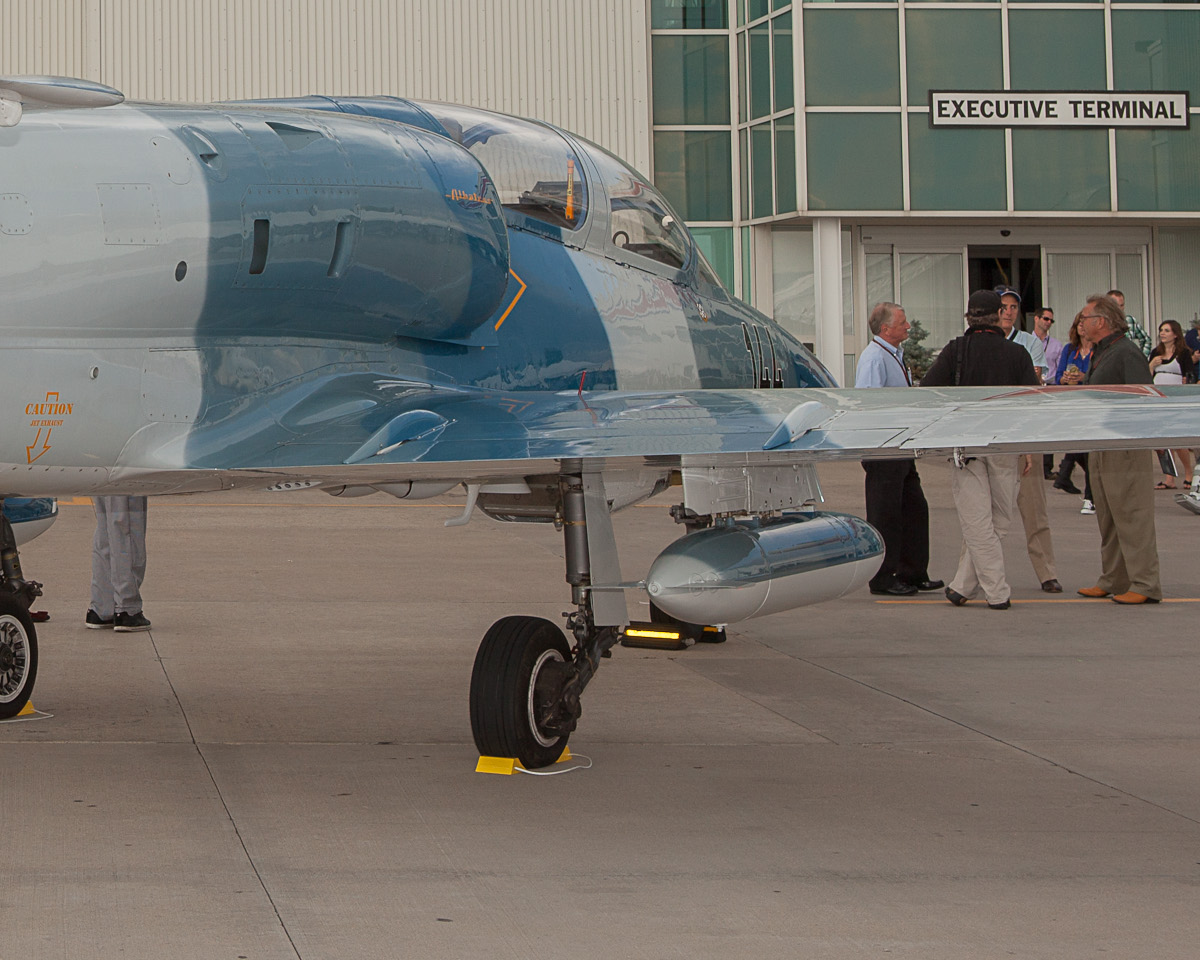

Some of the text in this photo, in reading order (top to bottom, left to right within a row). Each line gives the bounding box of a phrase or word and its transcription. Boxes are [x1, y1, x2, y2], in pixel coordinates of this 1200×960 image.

[936, 99, 1183, 120] EXECUTIVE TERMINAL
[24, 402, 75, 416] CAUTION
